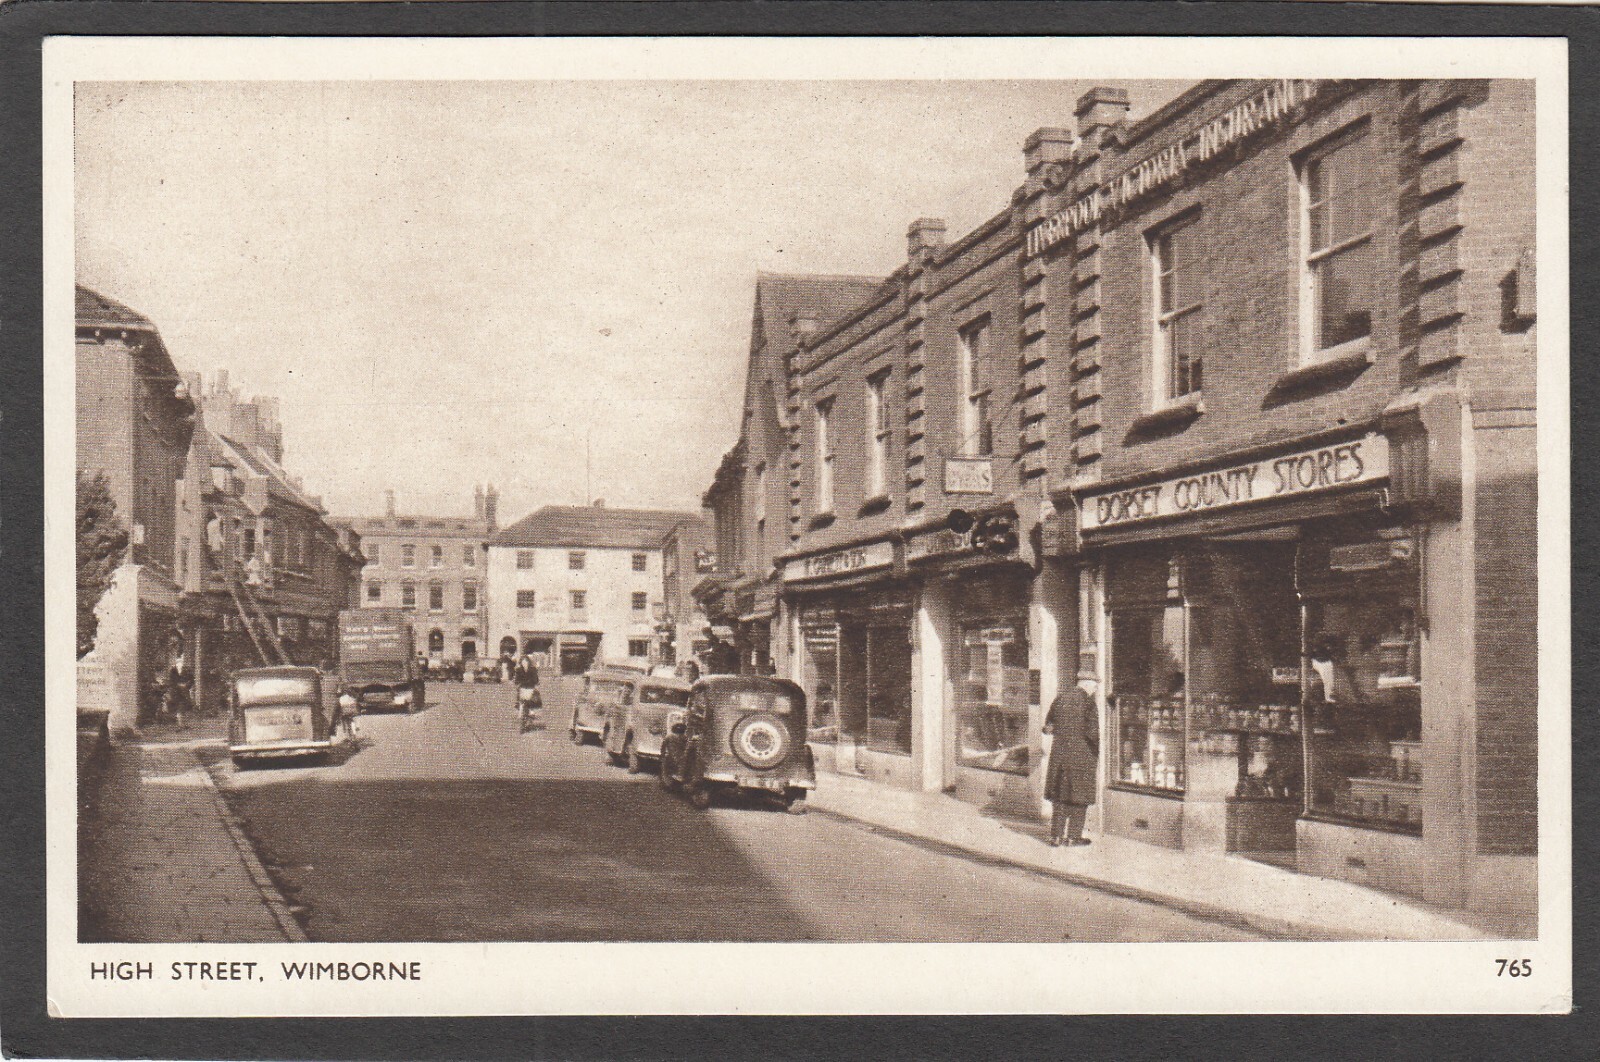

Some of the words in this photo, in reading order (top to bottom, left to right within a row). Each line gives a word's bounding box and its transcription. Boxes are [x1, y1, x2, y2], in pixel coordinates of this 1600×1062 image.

[1098, 486, 1161, 524] DORSET
[1174, 465, 1257, 512] COUNTY
[1272, 443, 1364, 494] STORES
